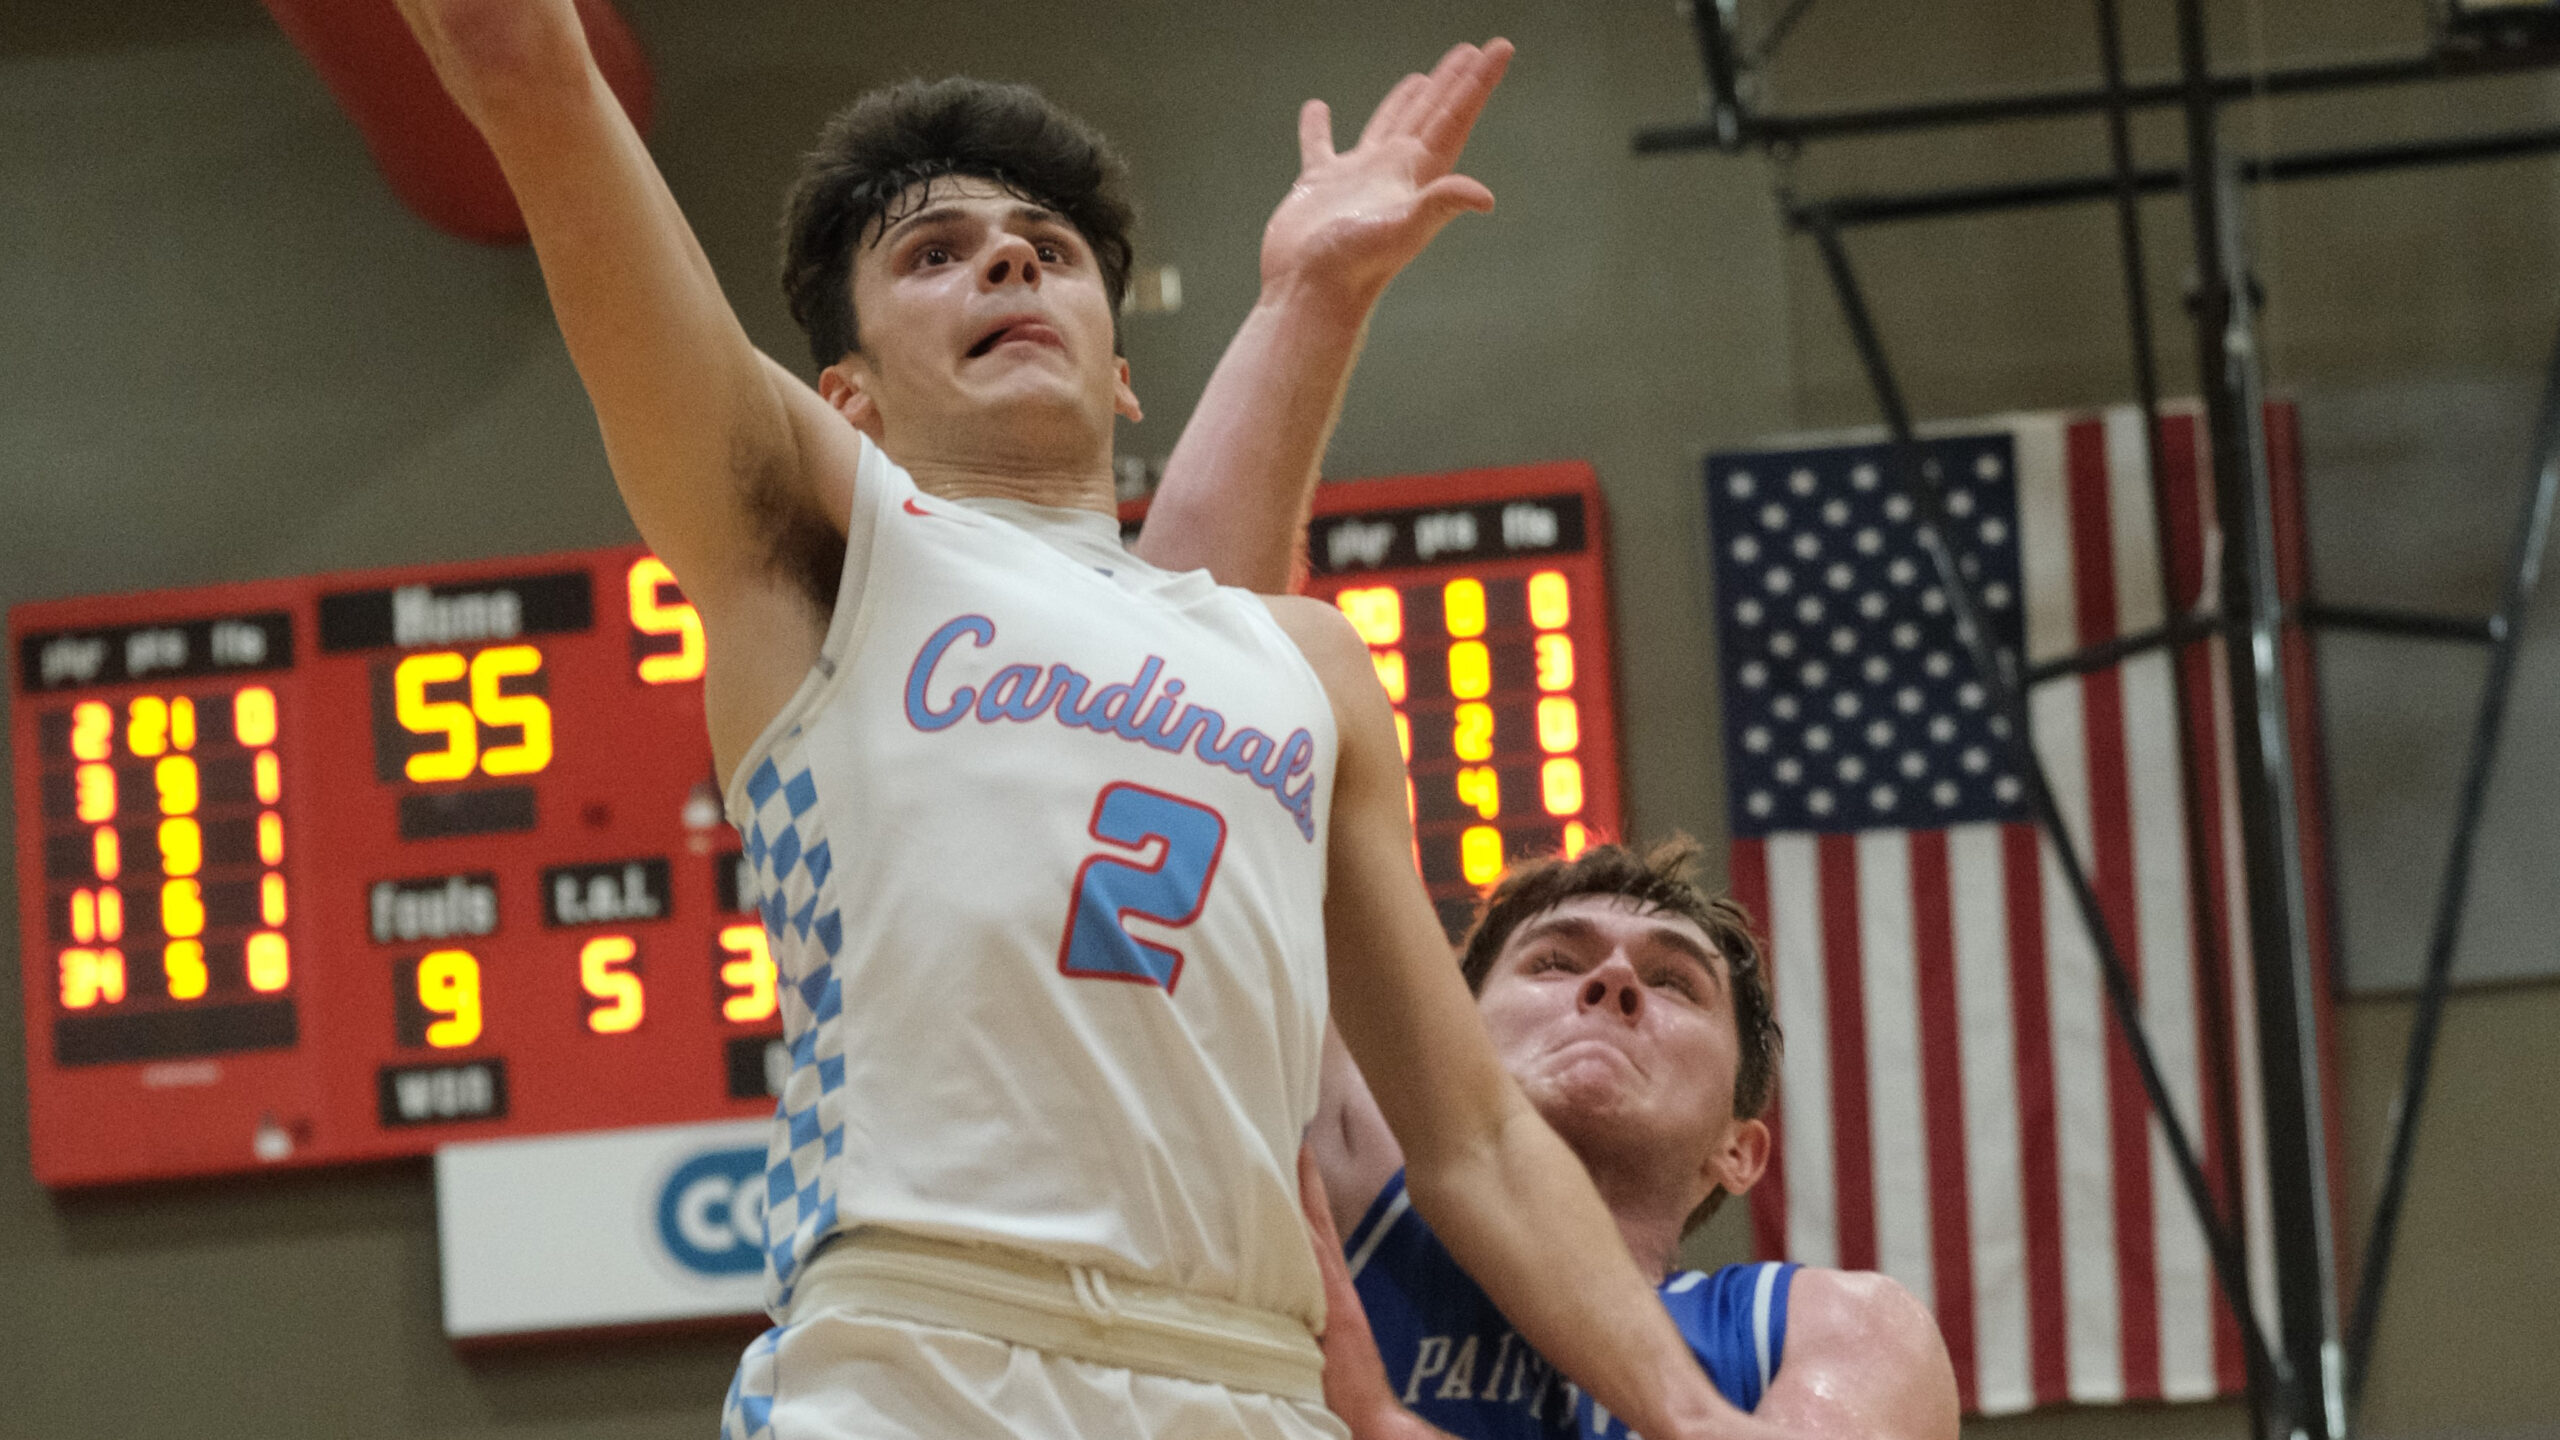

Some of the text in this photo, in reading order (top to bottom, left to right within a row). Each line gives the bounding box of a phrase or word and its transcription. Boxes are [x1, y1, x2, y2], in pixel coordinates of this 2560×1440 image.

[393, 645, 554, 783] 55
[904, 614, 1315, 843] Cardinals
[1452, 700, 1495, 763] 2
[254, 750, 280, 805] 1
[93, 826, 120, 880] 1
[257, 811, 285, 866] 1
[1057, 780, 1227, 996] 2
[260, 871, 288, 928] 1
[417, 924, 779, 1049] 9 5 3
